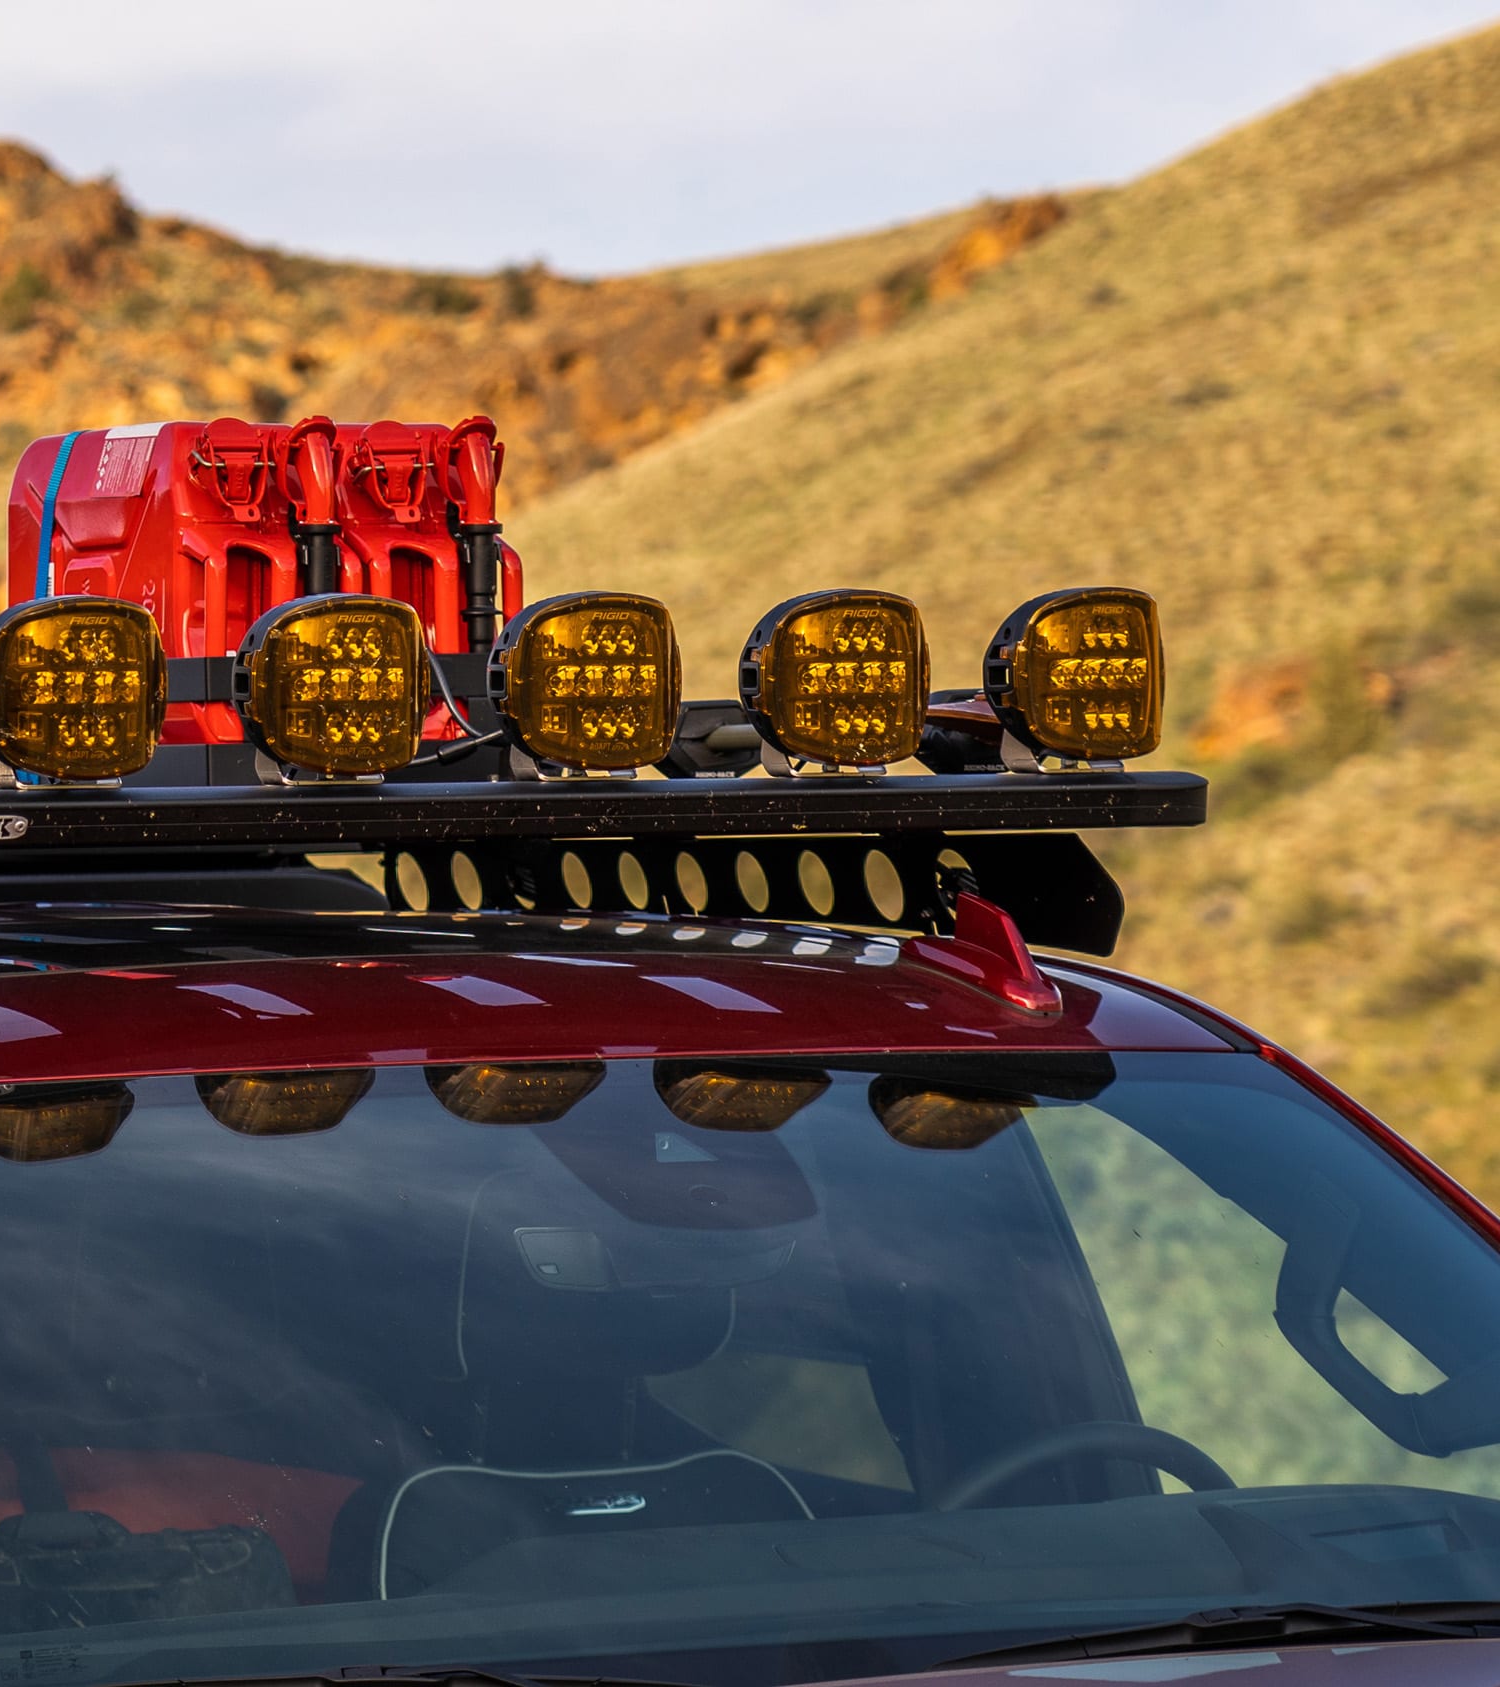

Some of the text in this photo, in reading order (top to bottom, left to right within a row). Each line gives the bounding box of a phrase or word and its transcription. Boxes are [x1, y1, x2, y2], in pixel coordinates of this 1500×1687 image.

[591, 611, 630, 620] RIGID
[842, 609, 880, 618] RIGID
[69, 615, 111, 625] RIGID
[337, 614, 376, 623] RIGID
